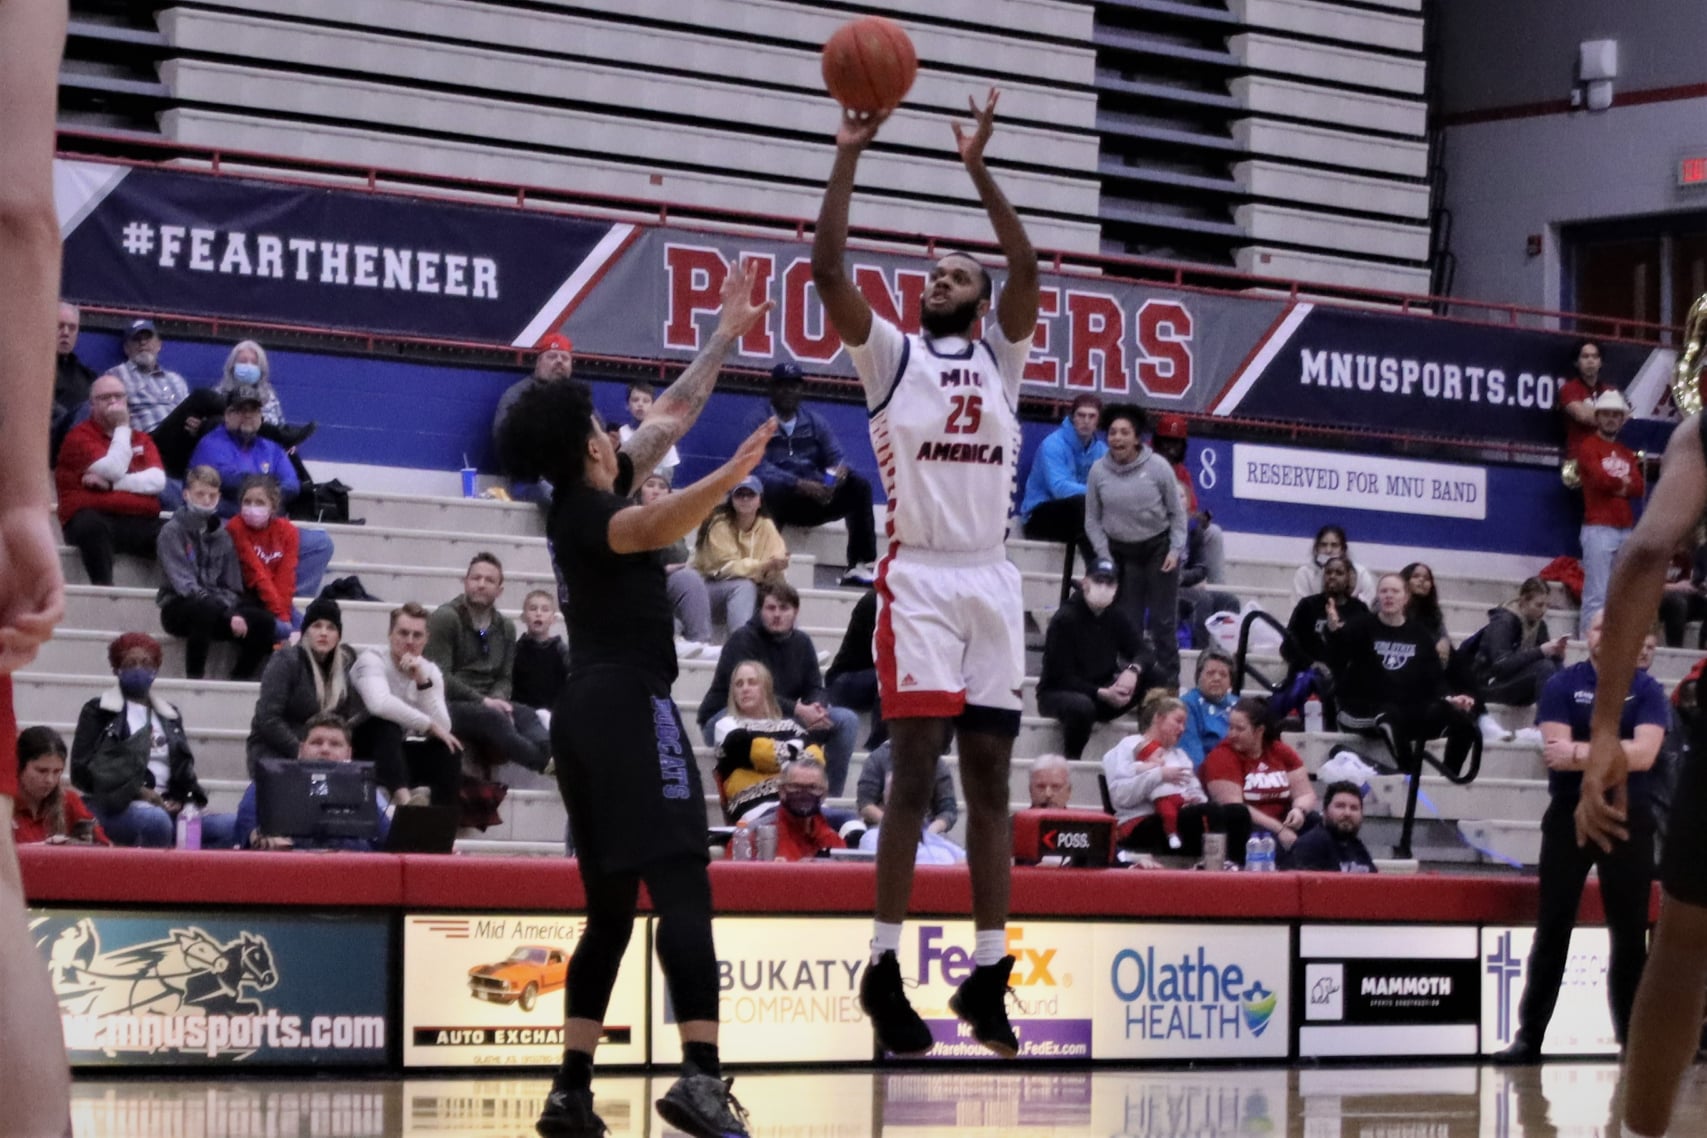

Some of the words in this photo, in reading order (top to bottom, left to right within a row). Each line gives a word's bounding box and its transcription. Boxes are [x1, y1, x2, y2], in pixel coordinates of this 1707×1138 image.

[122, 221, 499, 300] #FEARTHENEER
[664, 242, 1195, 400] PIONRS
[1300, 348, 1566, 410] MNUSPORTS.CO
[944, 395, 983, 434] 25
[916, 441, 1003, 465] AMERICA
[1200, 447, 1216, 489] 8
[1246, 461, 1340, 490] RESERVED
[1346, 471, 1379, 494] FOR
[1386, 475, 1425, 499] MNU
[1431, 480, 1477, 504] BAND
[1057, 832, 1090, 848] POSS.
[474, 919, 506, 939] Mid
[511, 920, 575, 940] America
[918, 926, 1057, 987] FeEx
[1111, 945, 1244, 1002] Olathe
[716, 960, 863, 991] BUKATY
[1361, 977, 1451, 996] MAMMOTH
[718, 995, 864, 1024] COMPANIES
[1126, 1004, 1240, 1040] HEALTH
[436, 1030, 485, 1045] AUTO
